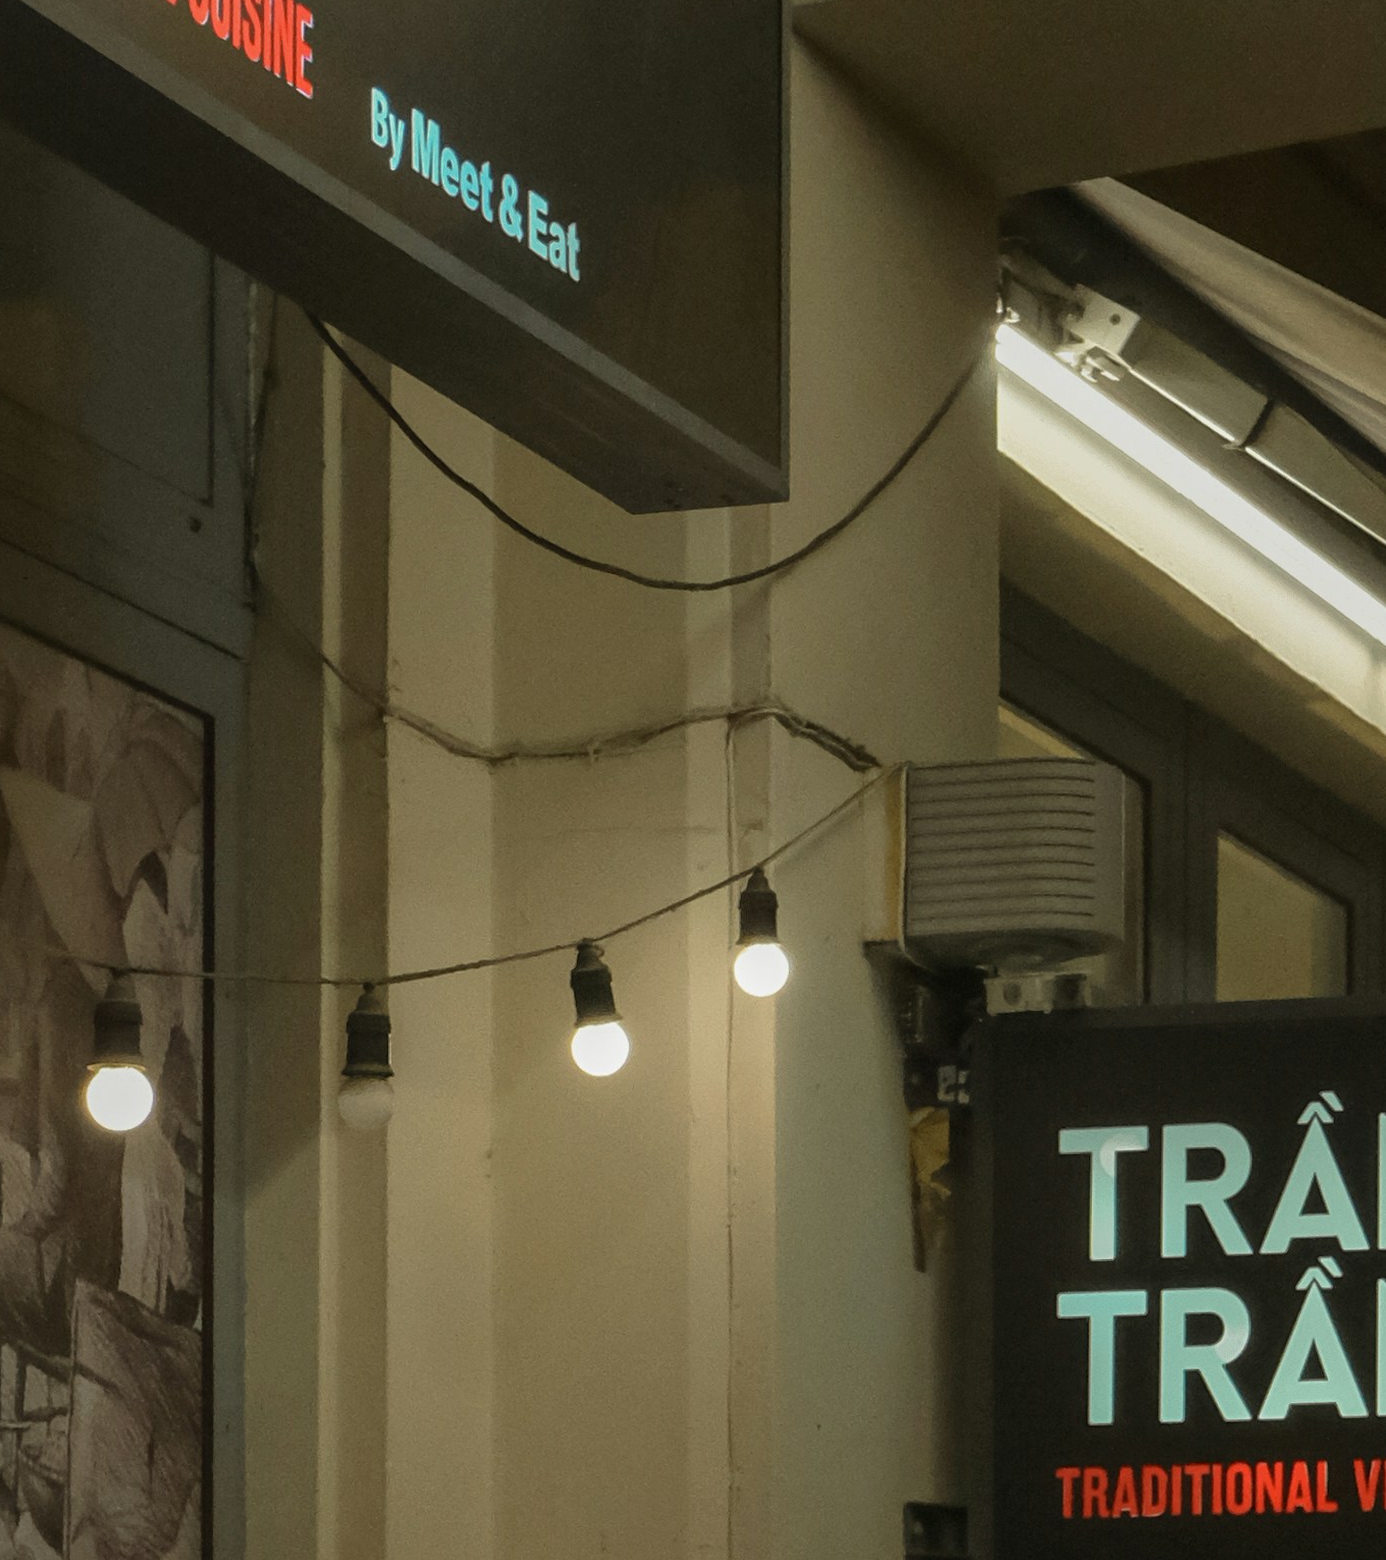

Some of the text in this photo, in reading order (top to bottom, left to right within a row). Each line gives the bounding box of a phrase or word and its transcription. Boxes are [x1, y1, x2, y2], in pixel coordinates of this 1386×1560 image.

[370, 87, 582, 283] By Meet & Eat
[1056, 1458, 1338, 1519] TRADITIONAL
